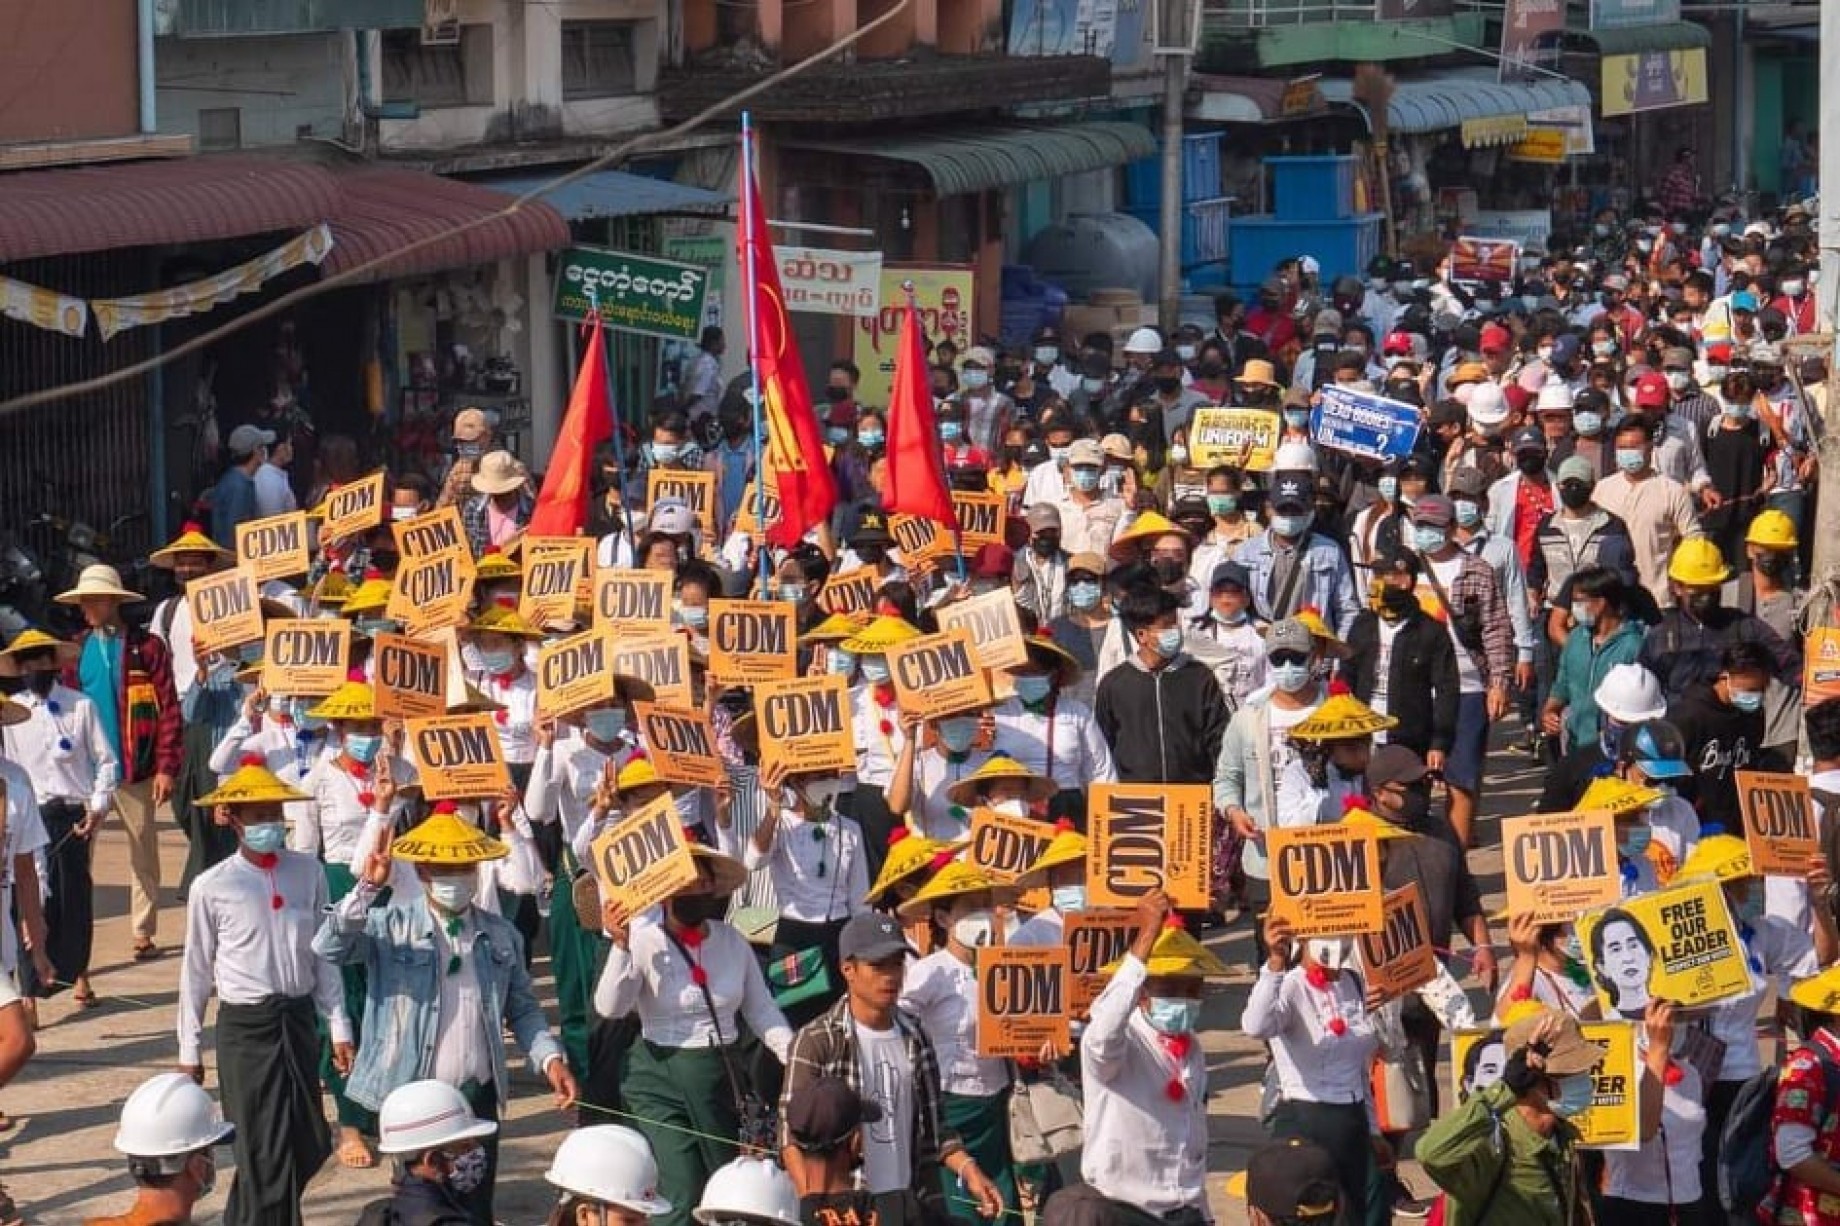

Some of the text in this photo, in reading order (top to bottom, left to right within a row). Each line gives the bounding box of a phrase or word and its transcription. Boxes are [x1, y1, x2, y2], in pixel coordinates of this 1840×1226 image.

[330, 483, 377, 521] CDM
[243, 520, 299, 561] CDM
[402, 517, 458, 557] CDM
[892, 515, 937, 554] CDM
[195, 576, 252, 625] CDM
[412, 557, 454, 607] CDM
[527, 559, 577, 598] CDM
[601, 581, 665, 619] CDM
[824, 575, 873, 613] CDM
[271, 630, 341, 667] CDM
[716, 612, 787, 654] CDM
[381, 645, 440, 697] CDM
[542, 637, 605, 691] CDM
[897, 640, 974, 691] CDM
[647, 713, 713, 757] CDM
[765, 689, 844, 740] CDM
[418, 725, 498, 768] CDM
[1748, 787, 1812, 838] CDM
[603, 810, 679, 887] CDM
[974, 823, 1054, 873] CDM
[1106, 795, 1165, 897] CDM
[1278, 838, 1371, 897] CDM
[1514, 825, 1608, 884] CDM
[1660, 896, 1706, 925] FREE
[1671, 917, 1708, 940] OUR
[1660, 929, 1729, 962] LEADER
[986, 963, 1063, 1016] CDM
